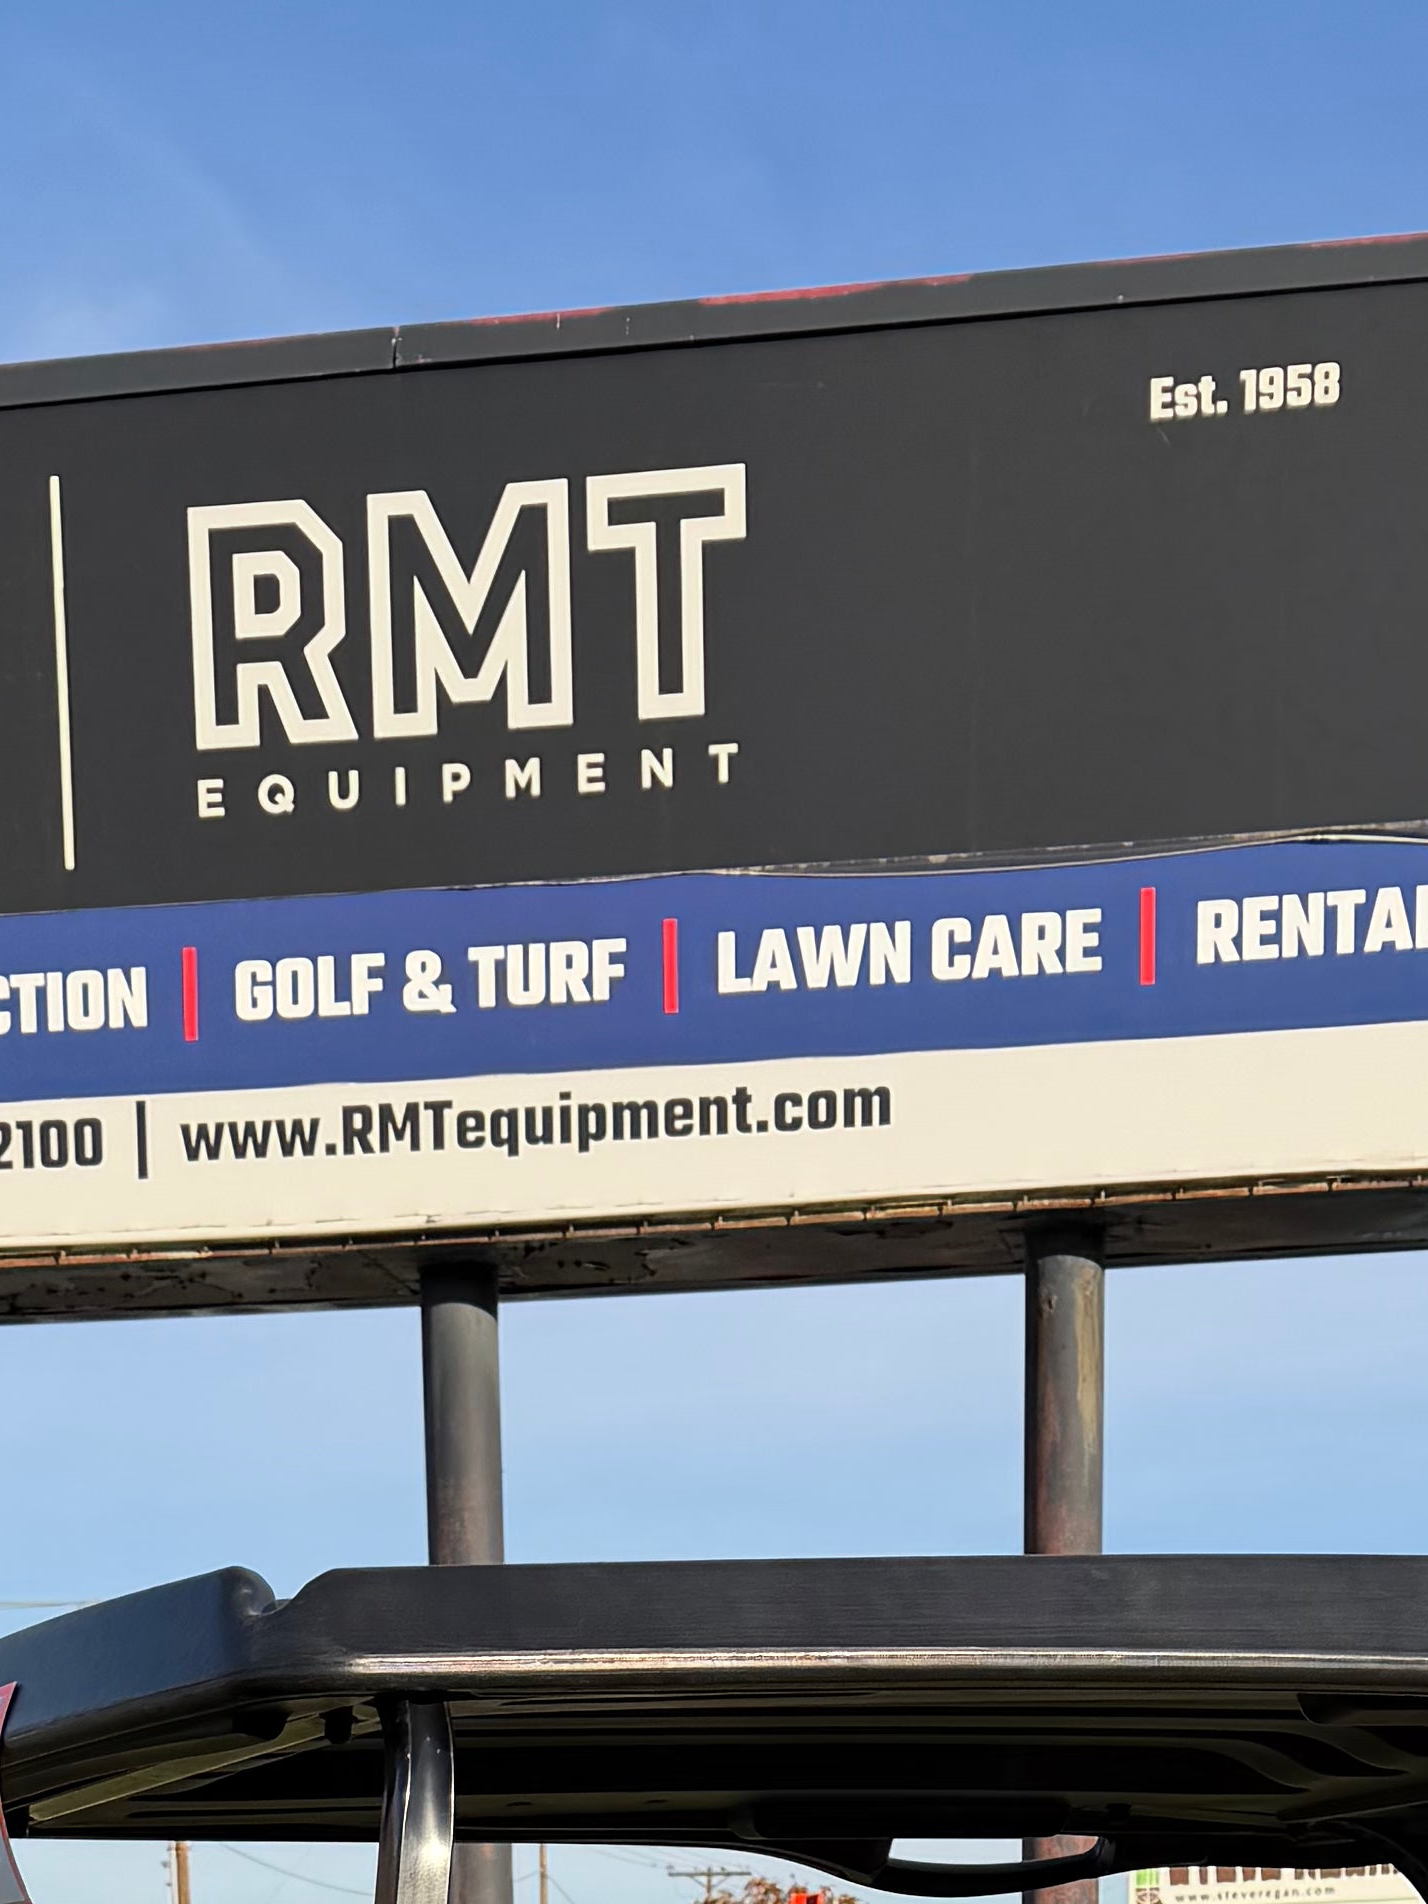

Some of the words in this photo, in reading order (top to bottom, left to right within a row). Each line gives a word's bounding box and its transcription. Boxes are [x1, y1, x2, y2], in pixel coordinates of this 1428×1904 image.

[1151, 376, 1227, 420] Est.
[1240, 362, 1340, 411] 1958
[187, 463, 747, 750] RMT
[196, 743, 739, 818] EQUIPMENT
[235, 953, 385, 1020] GOLF
[403, 950, 456, 1013] &
[468, 938, 626, 1008] TURF
[718, 921, 910, 993] LAWN
[932, 908, 1102, 980] CARE
[181, 1079, 891, 1162] www.RMTequipment.com
